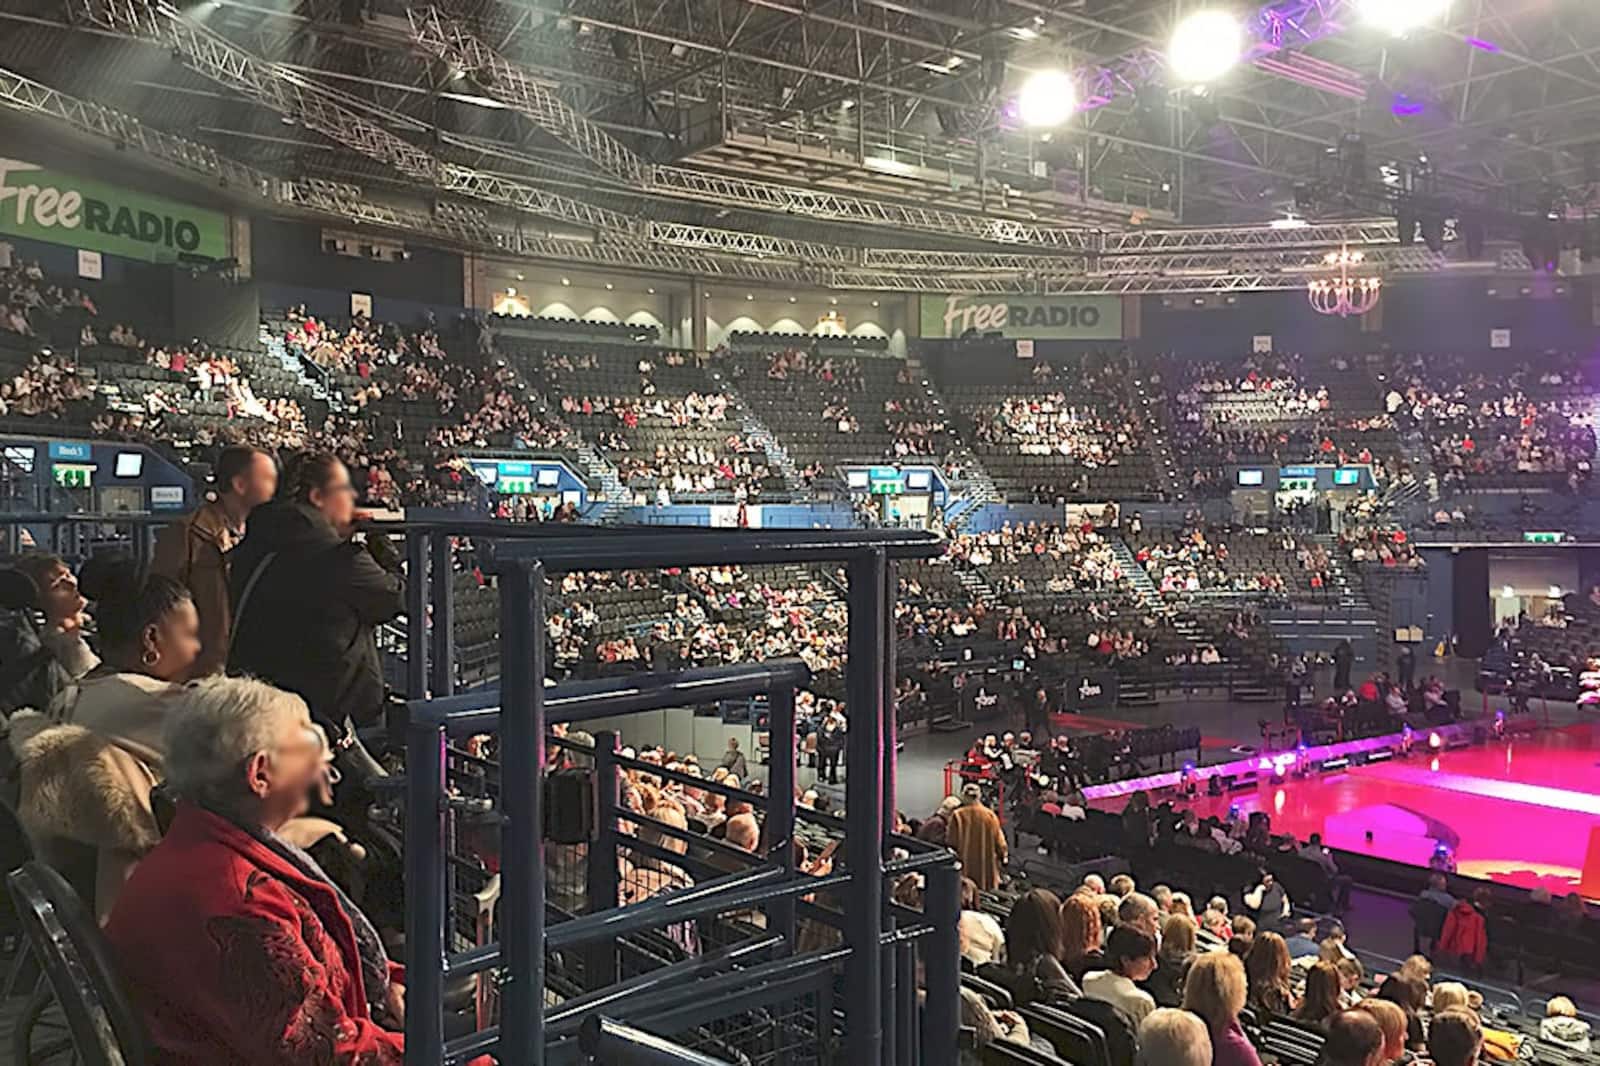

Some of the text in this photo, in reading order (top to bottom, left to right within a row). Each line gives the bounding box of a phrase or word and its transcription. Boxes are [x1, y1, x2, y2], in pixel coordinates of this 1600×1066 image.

[84, 199, 200, 251] RADIO
[943, 295, 1100, 338] Free RADIO
